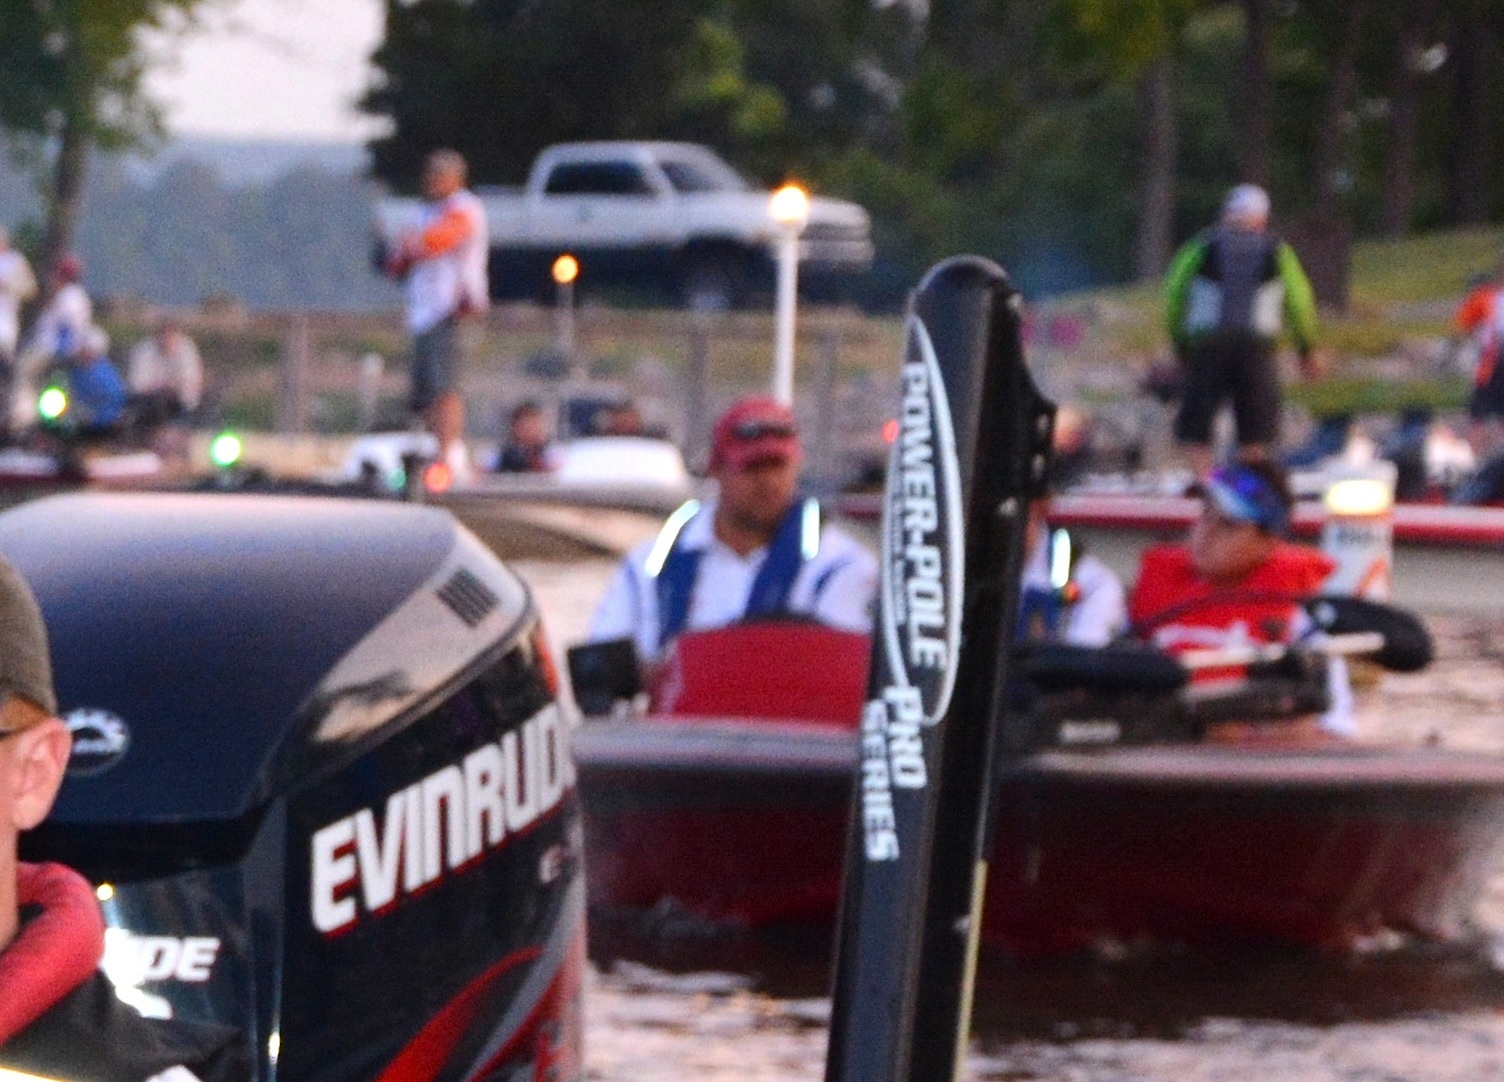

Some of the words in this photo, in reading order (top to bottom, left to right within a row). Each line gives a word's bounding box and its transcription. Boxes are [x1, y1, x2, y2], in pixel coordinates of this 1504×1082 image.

[900, 361, 947, 671] POWER-POLE
[860, 702, 900, 862] SERIES
[883, 684, 927, 789] PRO
